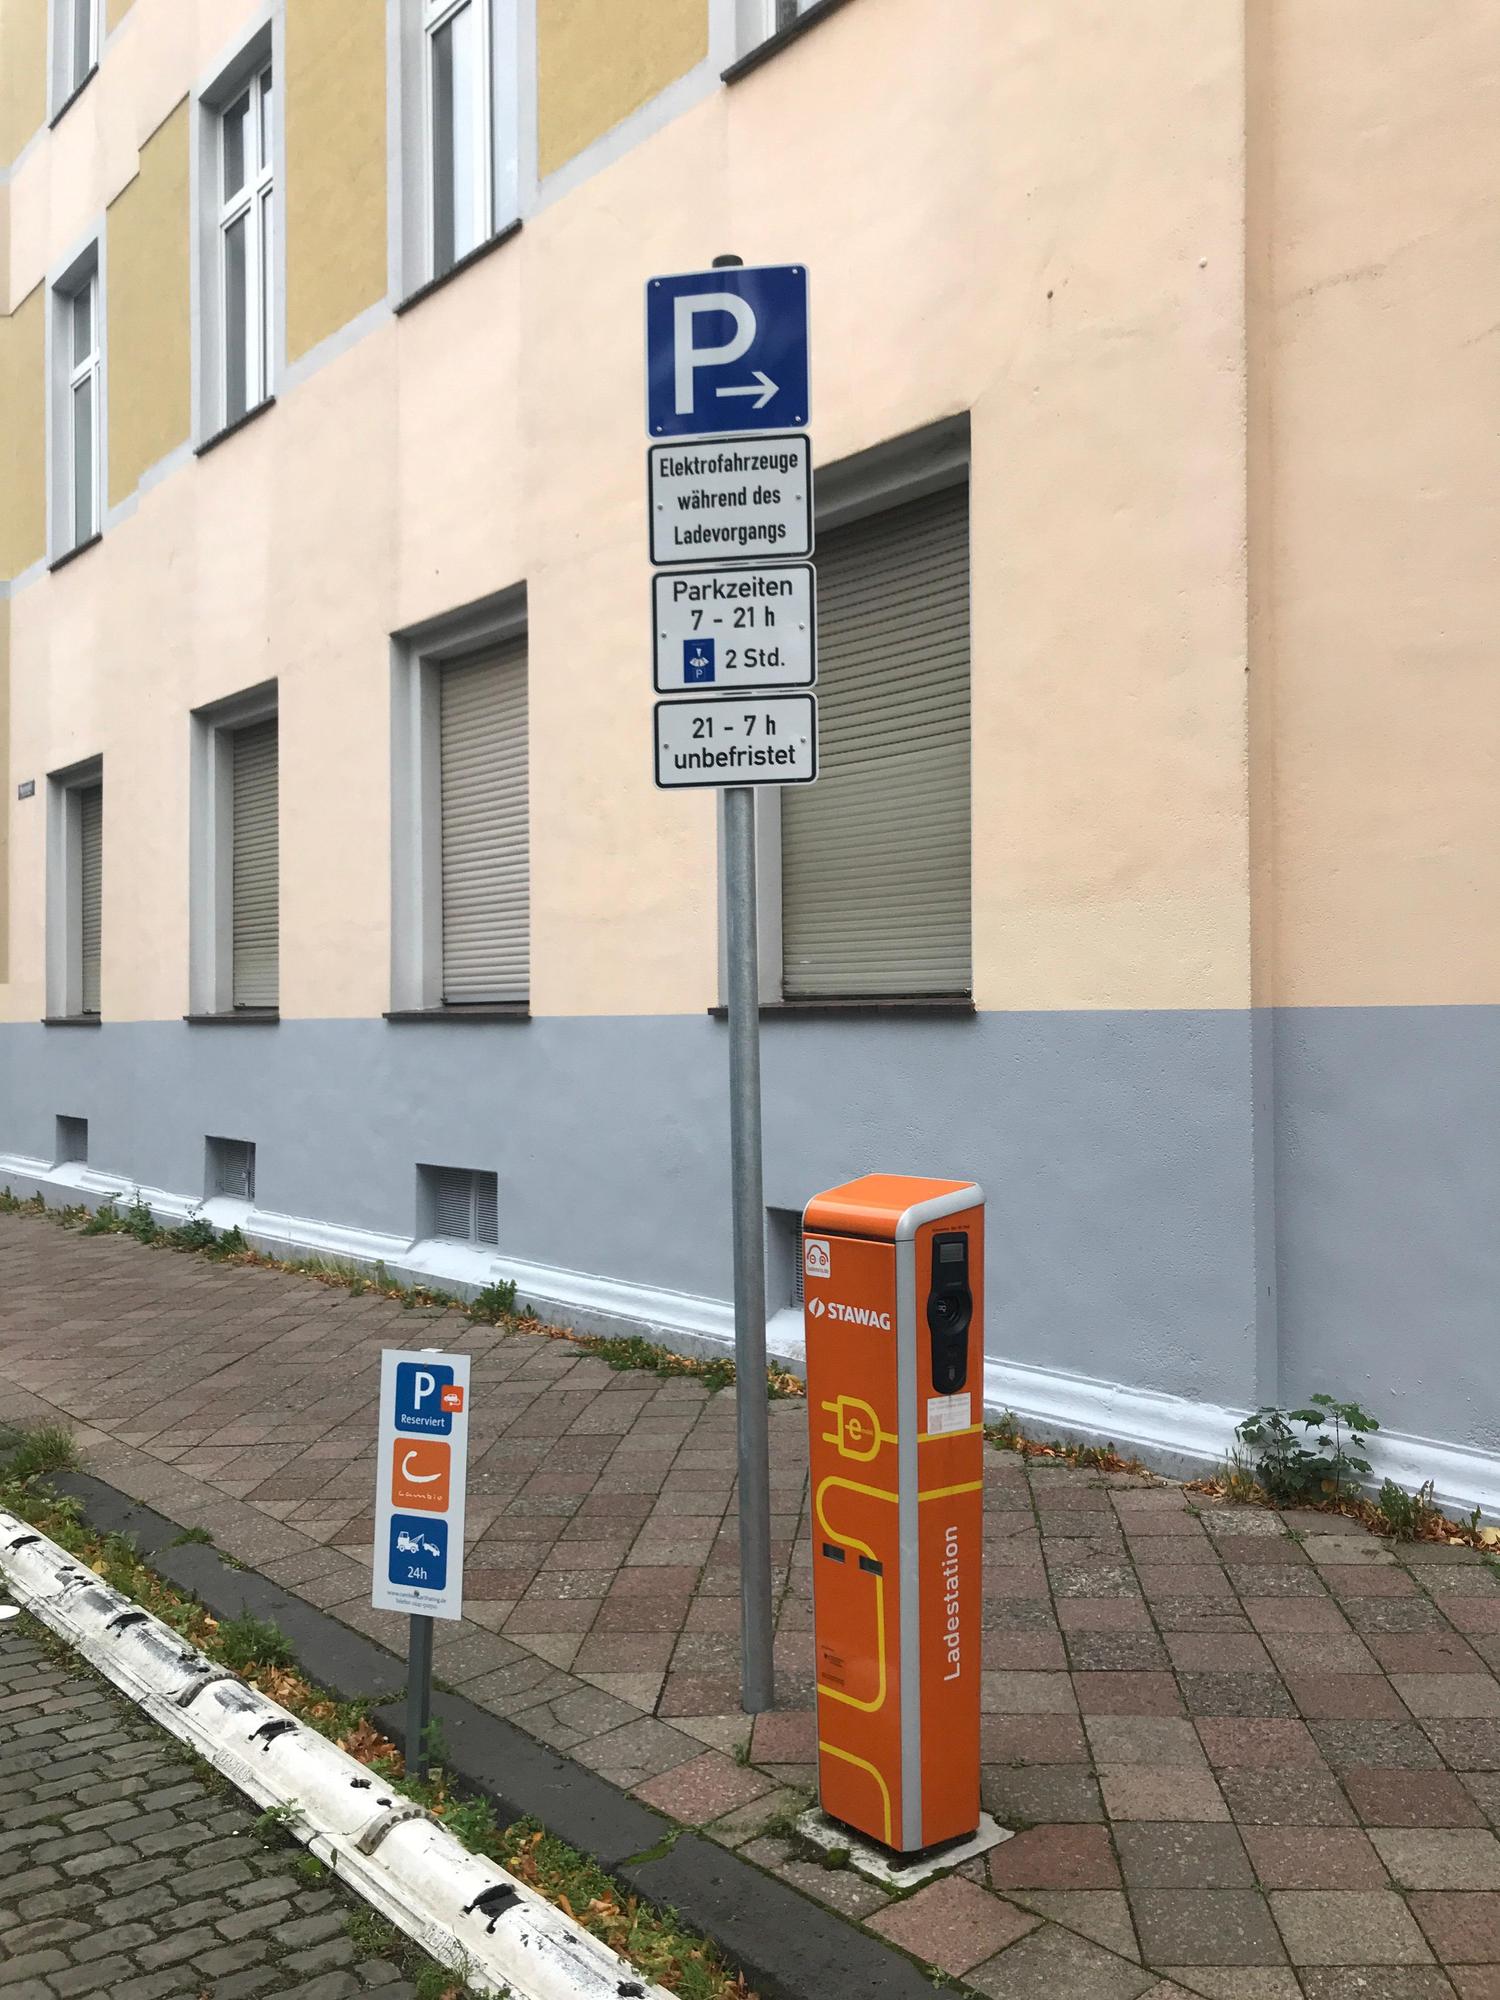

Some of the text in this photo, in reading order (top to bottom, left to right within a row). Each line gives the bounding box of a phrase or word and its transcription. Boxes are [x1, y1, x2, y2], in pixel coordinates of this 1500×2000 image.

[674, 292, 756, 415] P
[660, 452, 798, 478] Elektrofahrzeuge
[677, 485, 781, 511] während des
[674, 523, 786, 546] Ladevorgangs
[673, 577, 793, 602] Parkzeiten
[691, 610, 703, 631] 7
[733, 606, 754, 629] 21
[765, 606, 775, 627] h
[726, 647, 785, 669] 2 Std.
[692, 717, 713, 739] 21
[744, 715, 757, 736] 7
[766, 714, 776, 736] h
[674, 745, 796, 769] unbefristet
[827, 1302, 891, 1331] STAWAG
[414, 1371, 436, 1410] P
[400, 1413, 445, 1428] Reserviert
[407, 1565, 428, 1581] 24h
[944, 1525, 961, 1681] Ladestation
